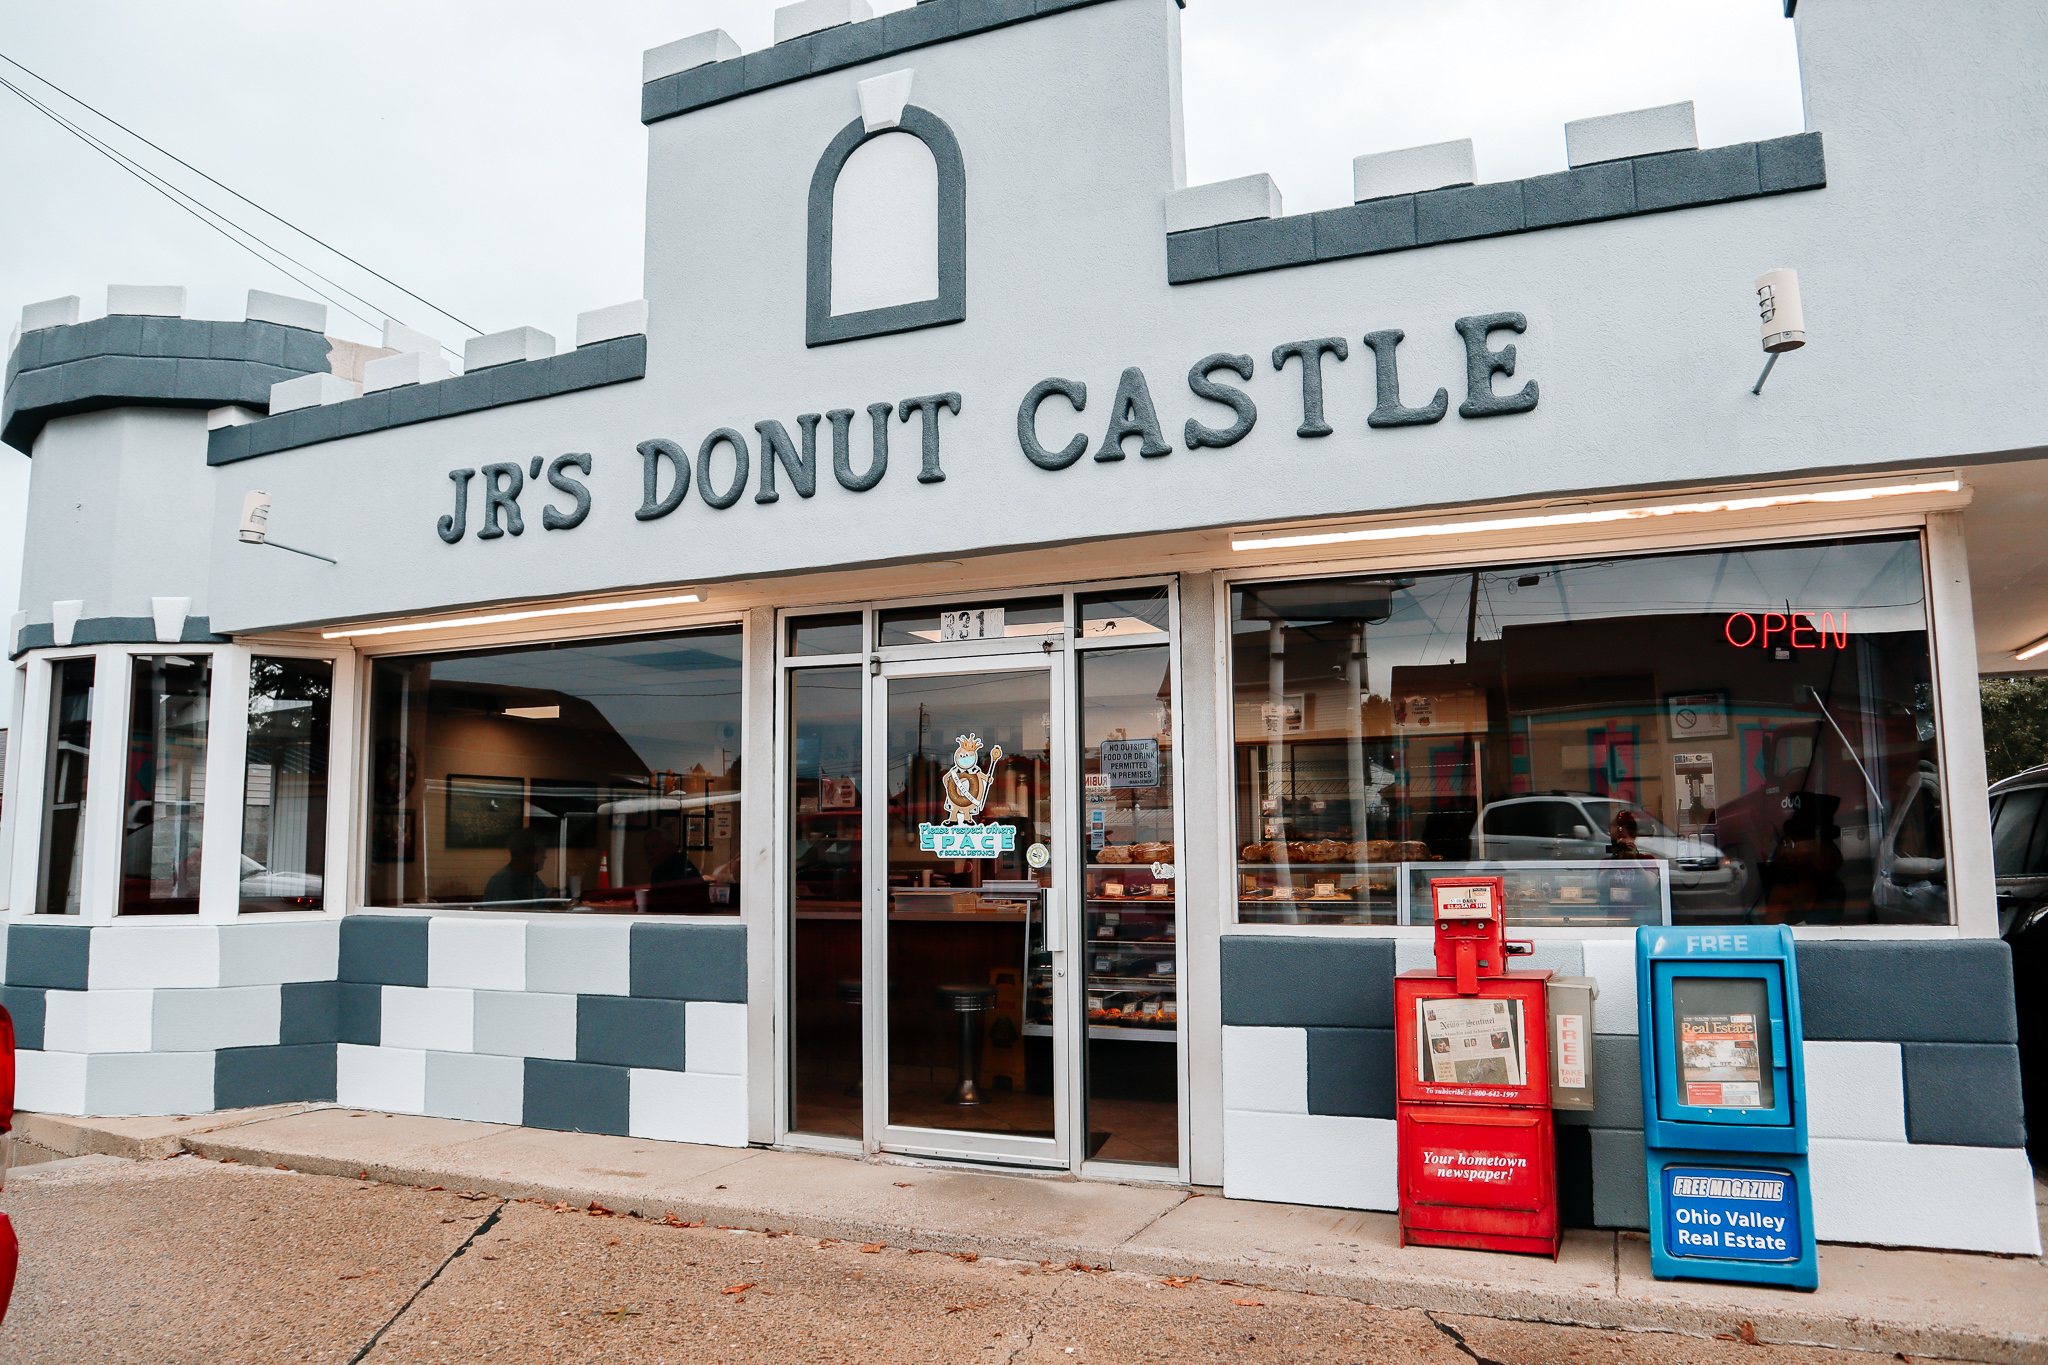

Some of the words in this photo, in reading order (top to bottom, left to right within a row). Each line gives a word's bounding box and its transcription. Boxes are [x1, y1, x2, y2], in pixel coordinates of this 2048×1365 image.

[437, 452, 592, 544] JR'S
[634, 391, 961, 522] DONUT
[1017, 311, 1540, 471] CASTLE
[1725, 612, 1847, 649] OPEN
[1103, 753, 1121, 761] FOOD
[1134, 752, 1155, 760] DRINK
[1110, 762, 1148, 770] PERMITTED
[1119, 771, 1152, 779] PREMISES
[920, 824, 949, 834] Please
[952, 825, 984, 835] respect
[985, 823, 1015, 834] others
[921, 834, 1014, 849] SPACE
[1686, 935, 1749, 953] FREE
[1681, 1021, 1710, 1034] Real
[1711, 1021, 1753, 1034] Estate
[1562, 1017, 1577, 1065] FREE
[1560, 1069, 1583, 1077] TAKE
[1562, 1076, 1582, 1084] ONE
[1435, 1088, 1467, 1096] subscribe:
[1423, 1152, 1455, 1165] Your
[1457, 1153, 1527, 1168] hometown
[1437, 1168, 1514, 1182] newspaper!
[1674, 1177, 1708, 1196] FREE
[1709, 1179, 1783, 1200] MAGAZINE
[1676, 1208, 1721, 1226] Ohio
[1725, 1210, 1785, 1233] Valley
[1678, 1229, 1719, 1247] Real
[1724, 1231, 1787, 1251] Estate
